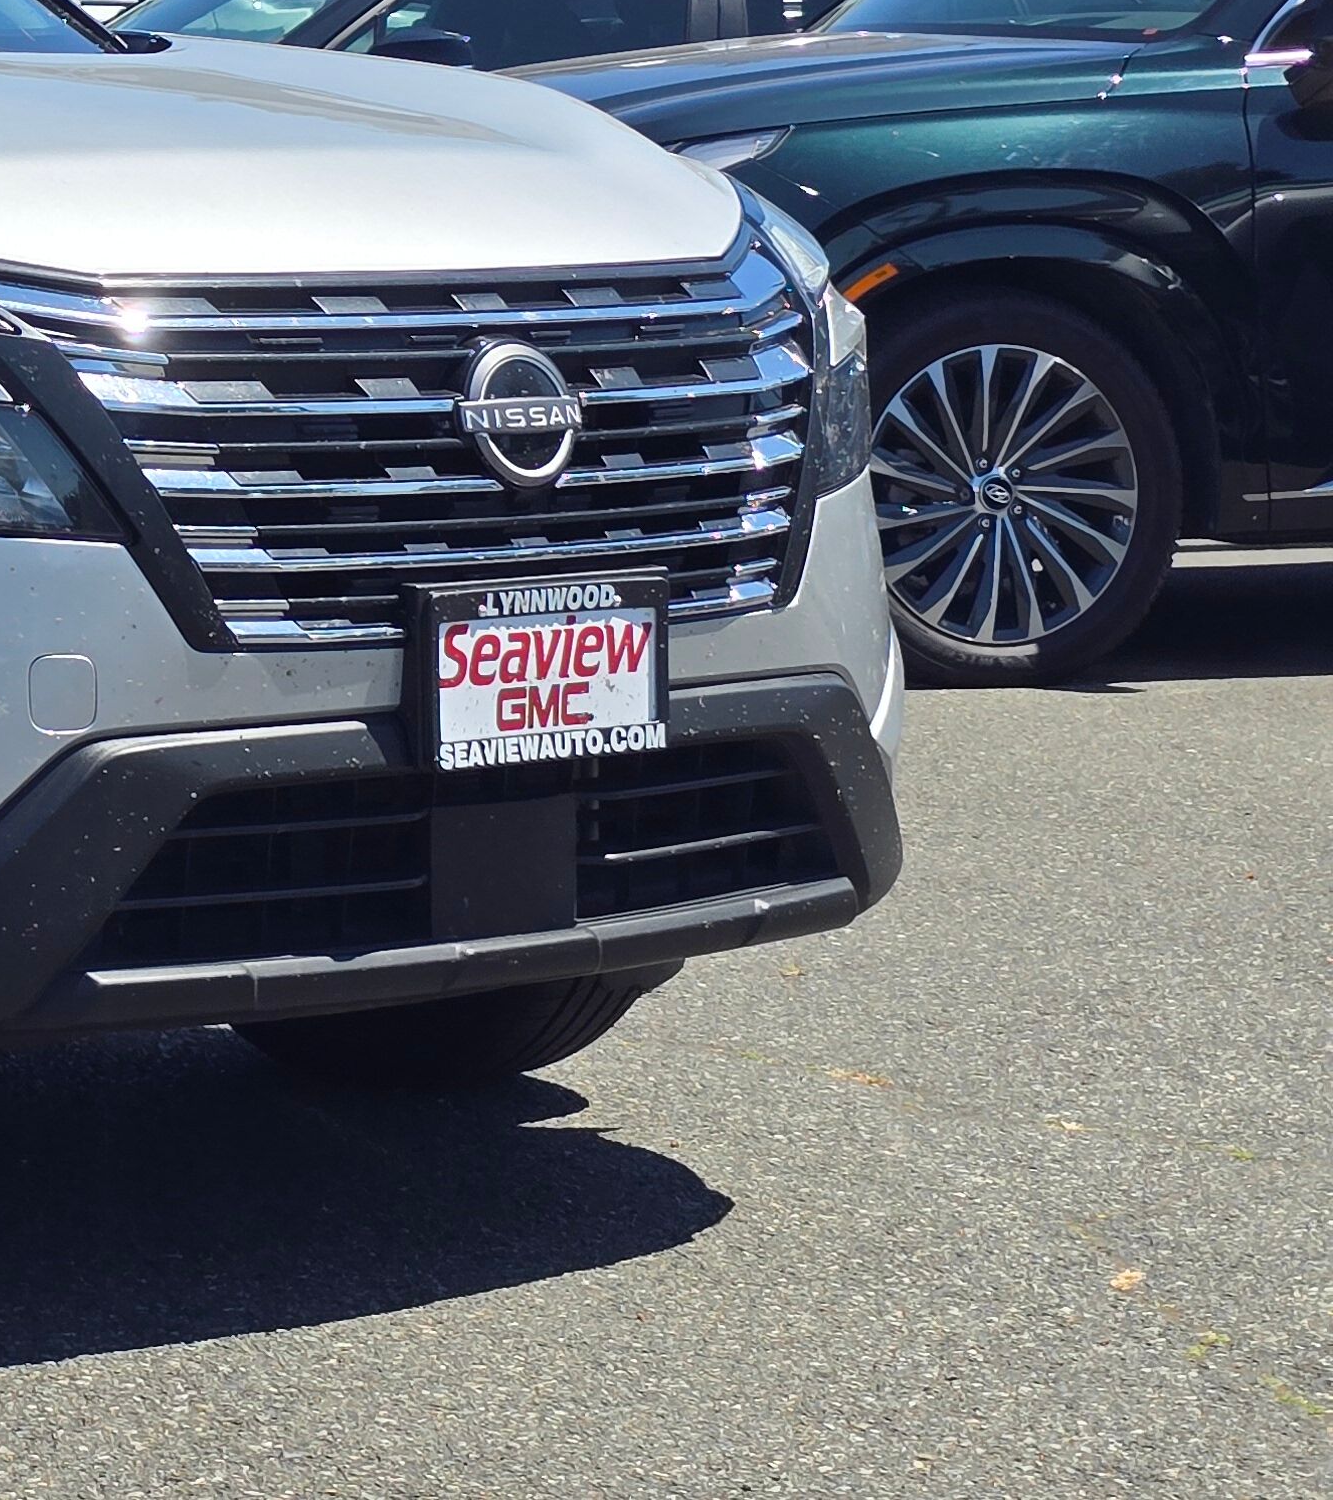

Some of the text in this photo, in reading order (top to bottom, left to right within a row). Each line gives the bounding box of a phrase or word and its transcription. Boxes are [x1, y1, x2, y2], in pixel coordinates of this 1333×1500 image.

[466, 404, 582, 430] NISSAN
[485, 584, 617, 616] LYNNWOOD
[439, 616, 652, 688] Seaview
[496, 680, 592, 732] GMC
[439, 723, 667, 771] SEAVIEWAUTO.COM
